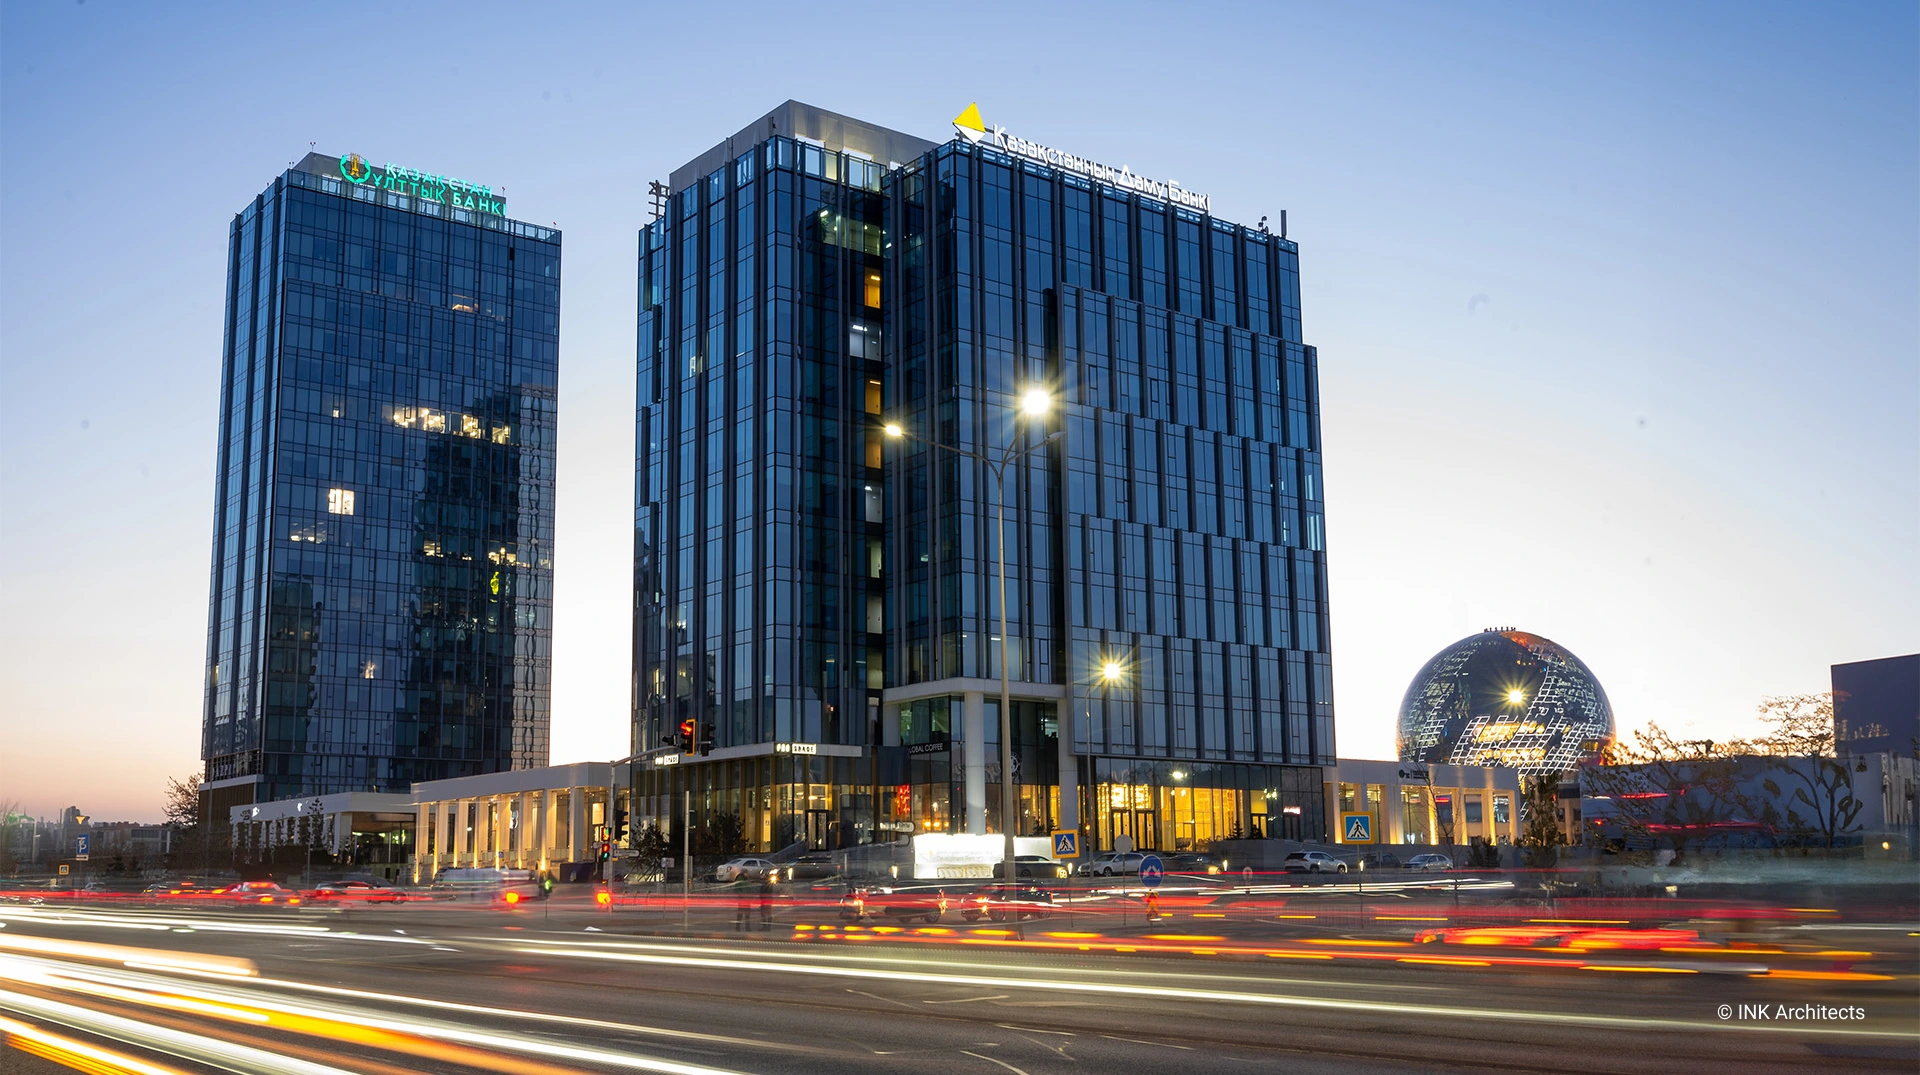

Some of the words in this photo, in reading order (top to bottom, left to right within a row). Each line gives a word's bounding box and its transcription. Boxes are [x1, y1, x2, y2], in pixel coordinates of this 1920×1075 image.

[386, 161, 493, 198] ҚАЗАҚСТАН
[993, 124, 1117, 185] Қазақстанның
[1119, 164, 1165, 200] Даму
[1168, 180, 1210, 215] Банкі
[924, 742, 944, 752] COFFEE
